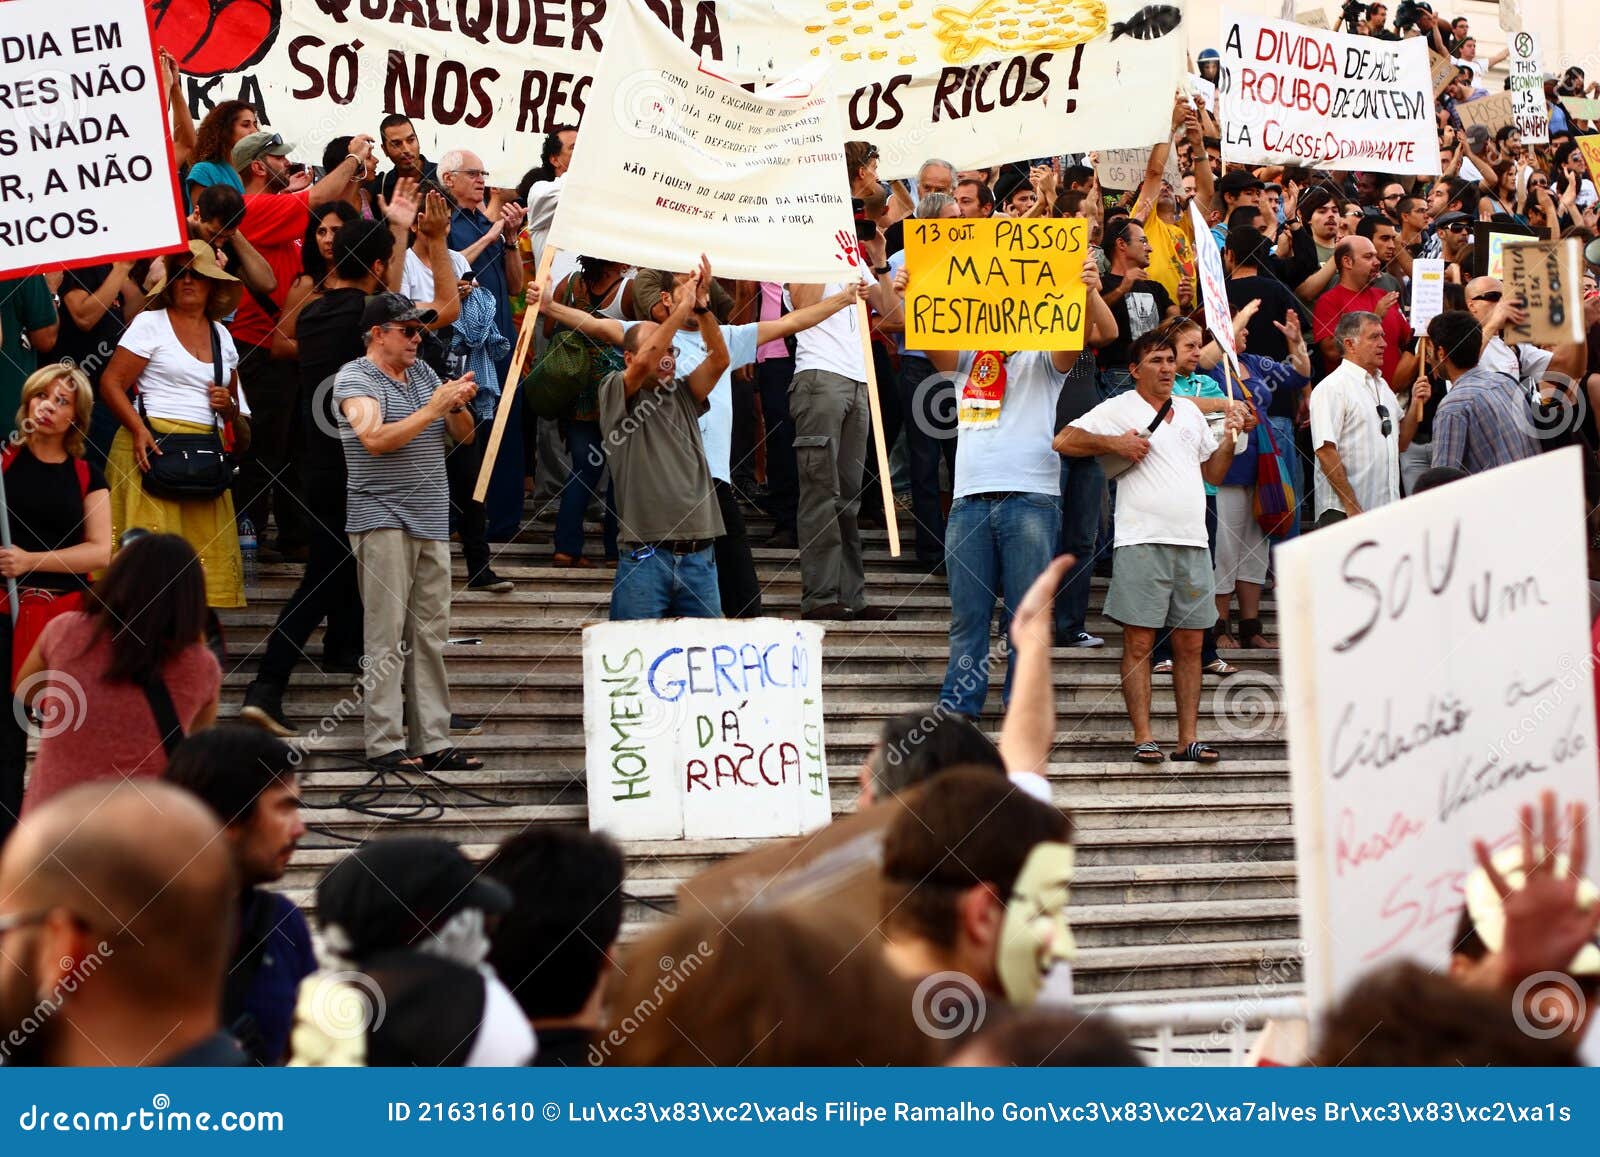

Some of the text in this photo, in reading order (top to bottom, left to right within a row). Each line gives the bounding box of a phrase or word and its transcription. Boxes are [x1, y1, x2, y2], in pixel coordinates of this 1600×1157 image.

[2, 22, 122, 64] DIA EM
[1226, 24, 1243, 59] A
[1255, 27, 1338, 75] DIVIDA
[1344, 47, 1370, 80] DE
[71, 63, 146, 100] NÃO
[288, 35, 364, 105] SÓ
[383, 50, 500, 128] NOS
[1511, 75, 1544, 92] ECONOMY
[1516, 61, 1537, 73] THIS
[661, 70, 688, 88] COMO
[721, 95, 763, 114] ENCARAR
[848, 74, 912, 130] OS
[1241, 68, 1331, 116] ROUBO
[1331, 87, 1350, 118] DE
[1352, 89, 1426, 120] ONTEM
[1522, 90, 1534, 103] IS
[30, 113, 130, 152] NADA
[708, 113, 721, 124] EM
[725, 120, 744, 131] QUE
[44, 168, 68, 196] A
[78, 153, 153, 190] NÃO
[623, 162, 646, 176] NÃO
[652, 171, 692, 191] FIQUEM
[696, 186, 710, 197] DO
[713, 190, 736, 202] LADO
[775, 197, 791, 205] DA
[655, 196, 716, 220] RECUSEM-SE
[734, 215, 760, 224] USAR
[768, 215, 775, 224] A
[781, 215, 815, 225] FORÇA
[915, 223, 941, 245] 13
[995, 221, 1081, 252] PASSOS
[947, 255, 1057, 287] MATA
[913, 292, 1082, 334] RESTAURAÇÃO
[1332, 517, 1460, 652] SOU
[601, 648, 651, 801] HOMENS
[696, 700, 749, 748] DÁ
